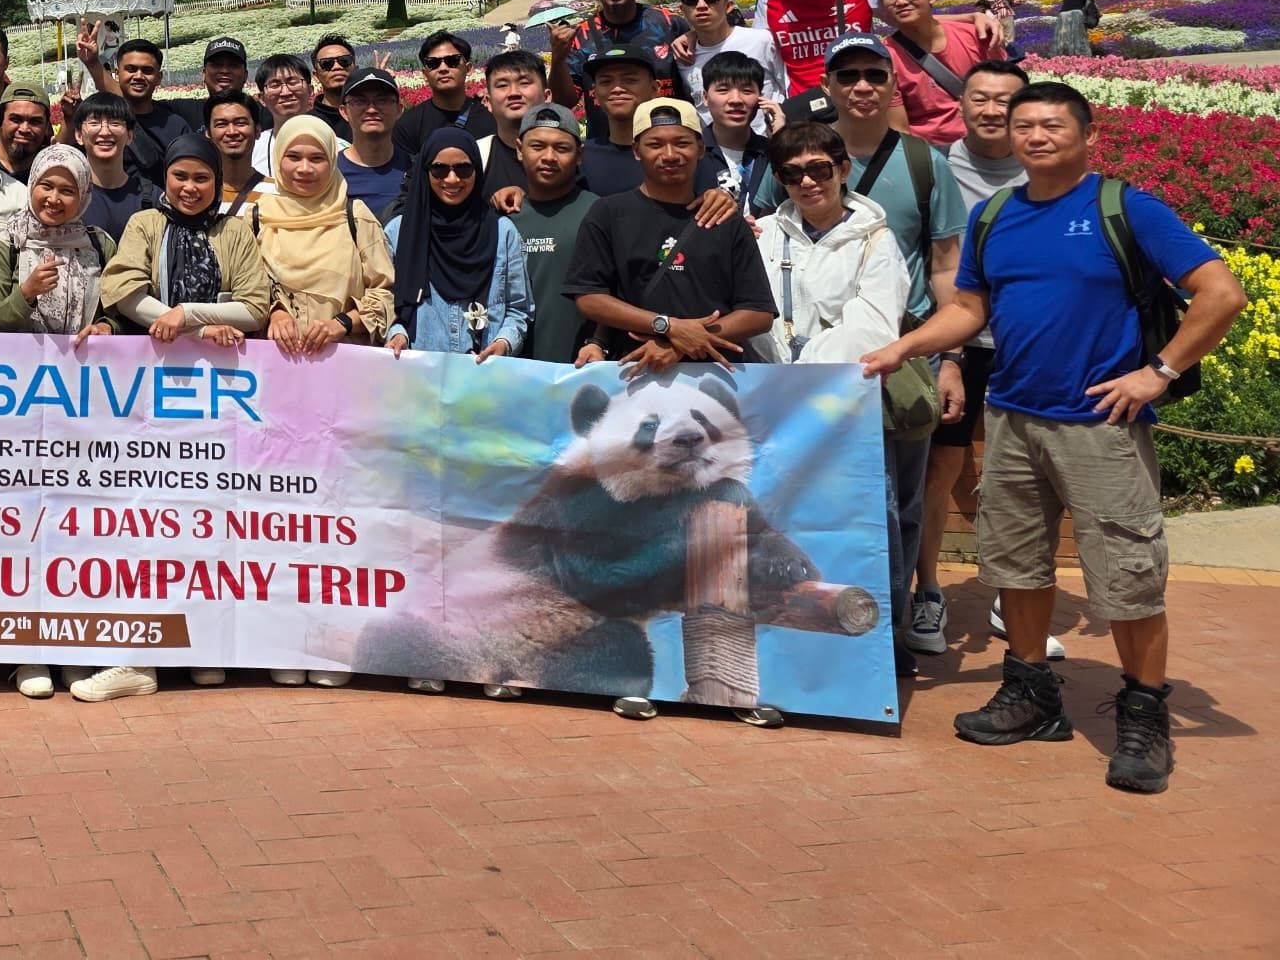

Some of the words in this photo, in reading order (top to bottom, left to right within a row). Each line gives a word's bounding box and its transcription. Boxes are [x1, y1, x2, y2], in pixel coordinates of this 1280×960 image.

[776, 21, 862, 47] Emirats
[831, 37, 875, 53] adidas
[792, 44, 809, 60] FLY
[87, 440, 120, 463] (M)
[126, 440, 171, 459] SDN
[179, 441, 226, 460] BHD
[76, 470, 92, 488] &
[98, 470, 209, 490] SERVICES
[216, 473, 262, 492] SDN
[269, 474, 318, 494] BHD
[30, 507, 46, 542] /
[58, 507, 80, 537] 4
[93, 507, 180, 539] DAYS
[192, 509, 214, 539] 3
[226, 510, 358, 546] NIGHTS
[45, 557, 277, 601] COMPANY
[288, 563, 406, 608] TRIP
[38, 618, 89, 641] MAY
[96, 620, 163, 644] 2025
